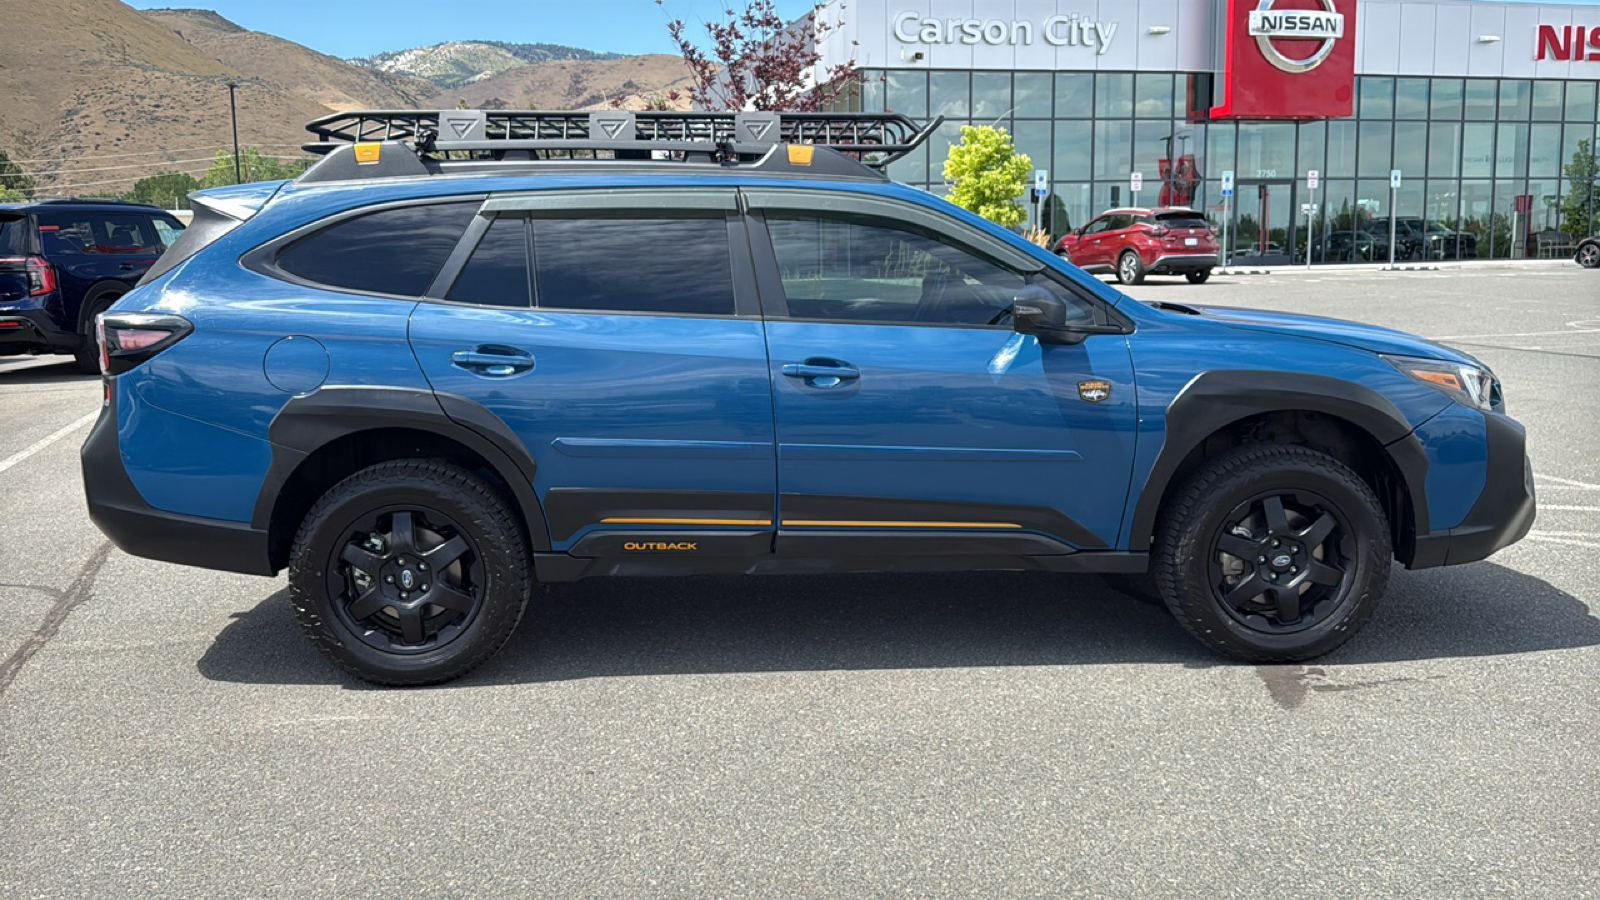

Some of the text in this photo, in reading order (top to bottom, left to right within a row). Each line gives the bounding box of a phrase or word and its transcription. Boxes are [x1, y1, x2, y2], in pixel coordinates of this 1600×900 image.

[1261, 16, 1337, 31] NISSAN
[894, 10, 1118, 55] Carson City
[1257, 169, 1277, 178] 2750
[623, 541, 698, 550] OUTBACK
